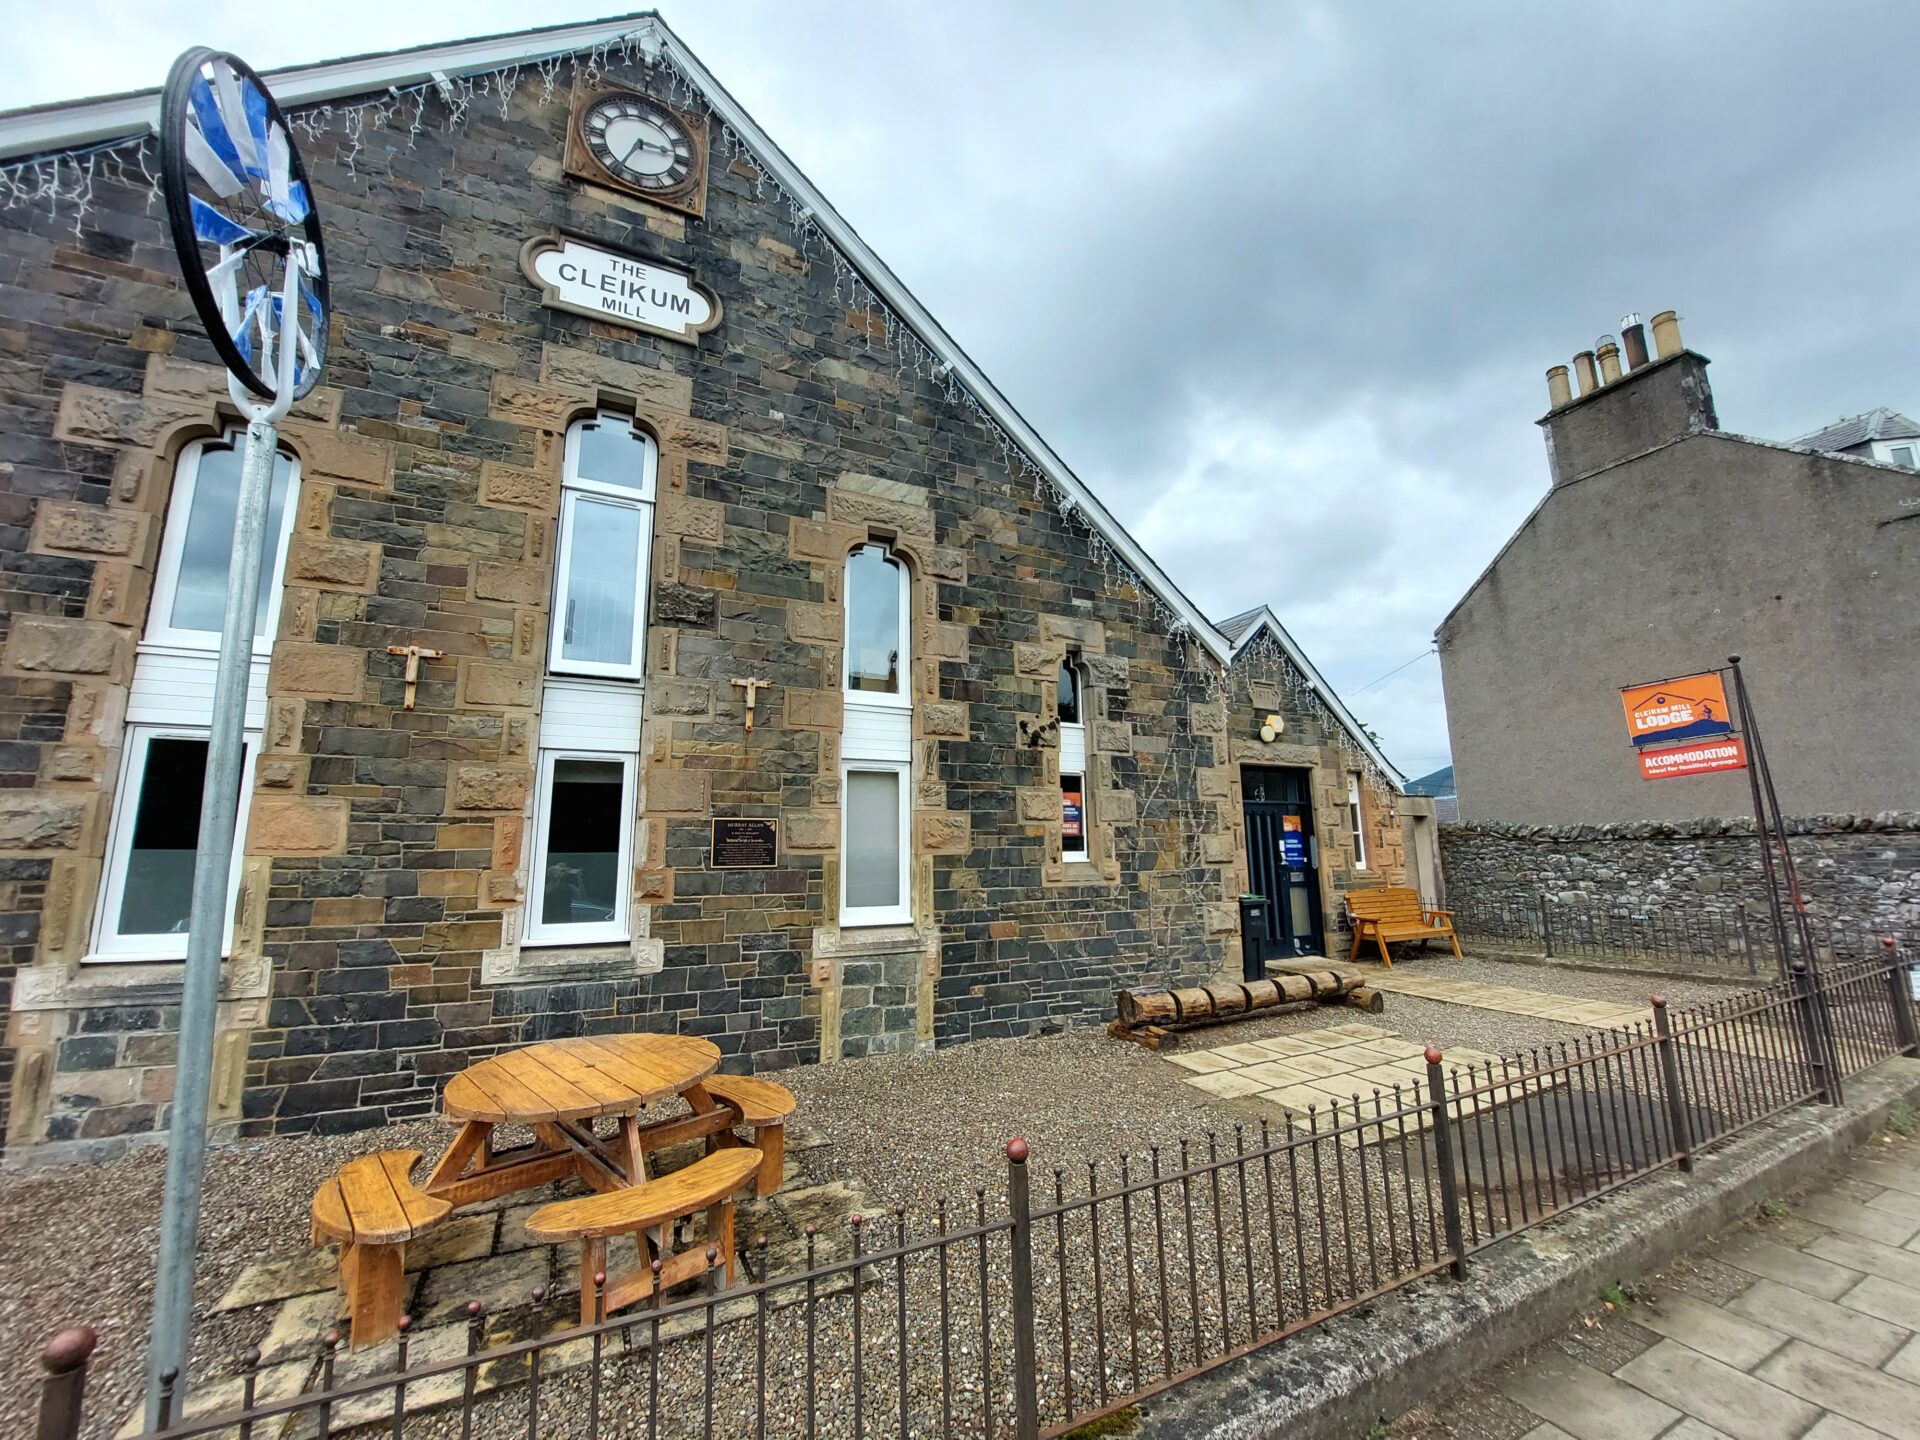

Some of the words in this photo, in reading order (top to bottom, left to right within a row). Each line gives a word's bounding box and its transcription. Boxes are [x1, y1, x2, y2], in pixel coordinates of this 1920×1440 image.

[609, 259, 647, 281] THE
[558, 263, 690, 315] CLEIKUM
[601, 297, 646, 319] MILL
[1671, 704, 1692, 712] MILL
[1635, 710, 1694, 730] LODGE
[1645, 746, 1738, 768] ACCOMMODATION
